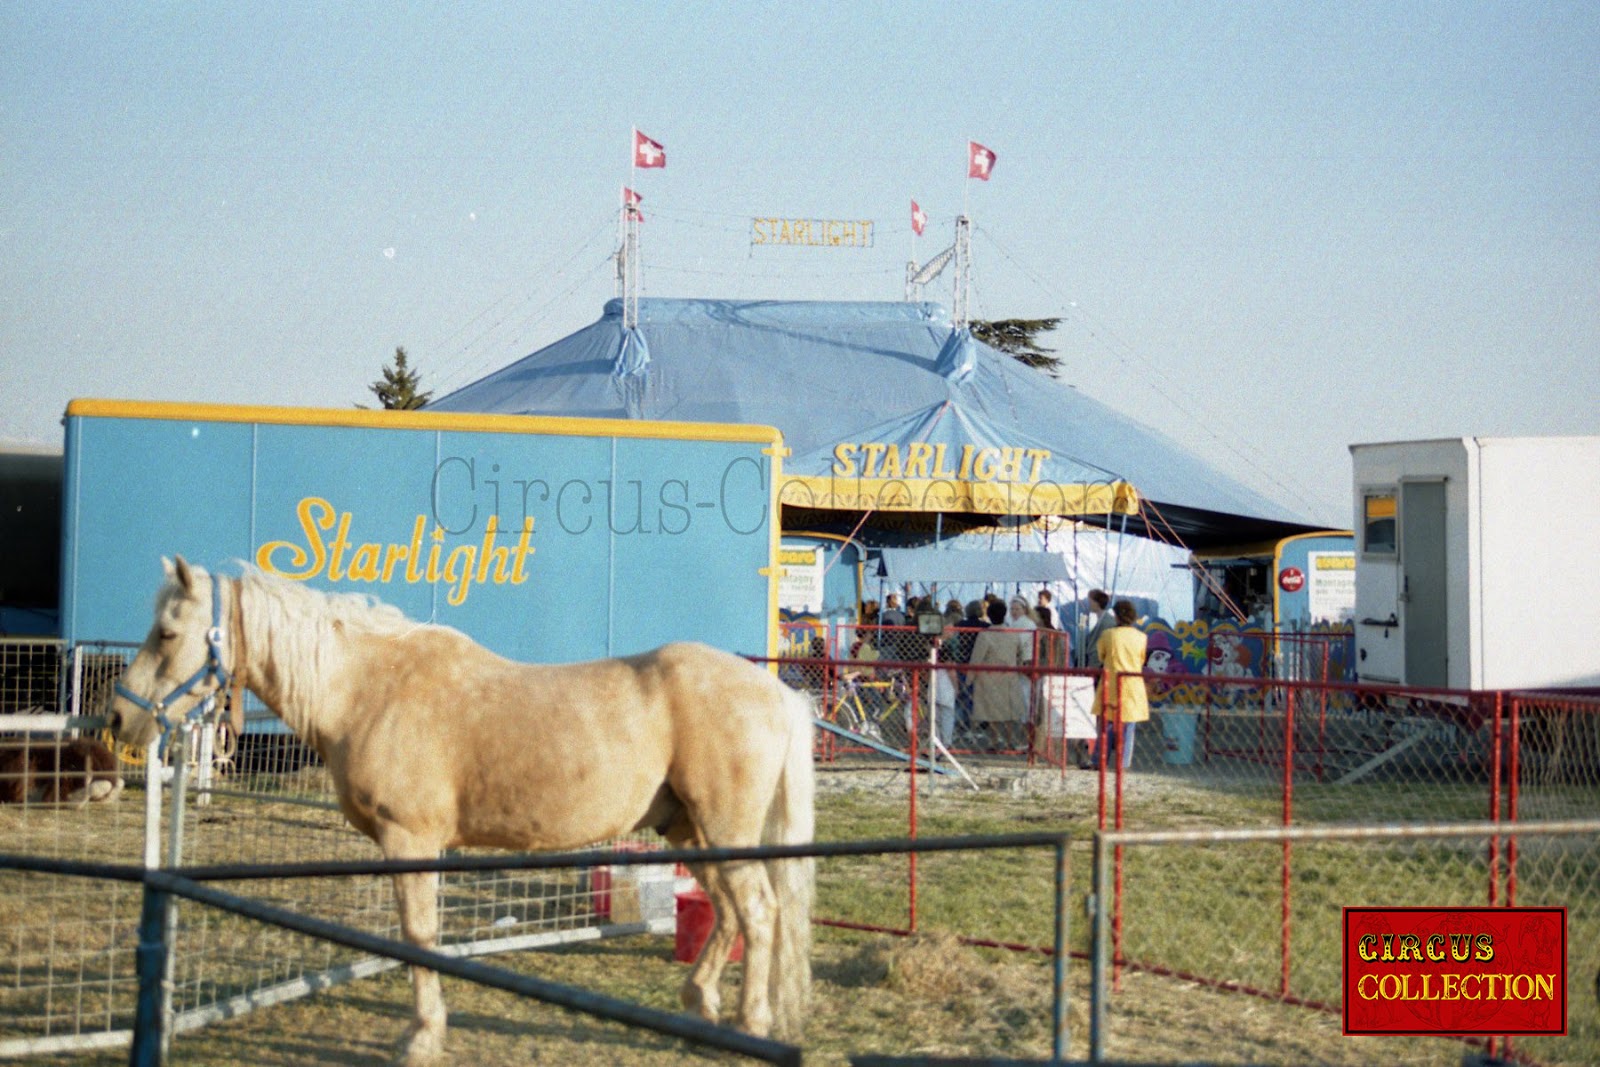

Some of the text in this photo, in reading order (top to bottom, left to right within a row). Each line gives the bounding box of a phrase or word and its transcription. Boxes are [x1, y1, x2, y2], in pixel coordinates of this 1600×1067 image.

[753, 217, 873, 247] STARLIGHT
[833, 442, 1052, 483] STARLIGHT
[256, 497, 536, 607] Starlight
